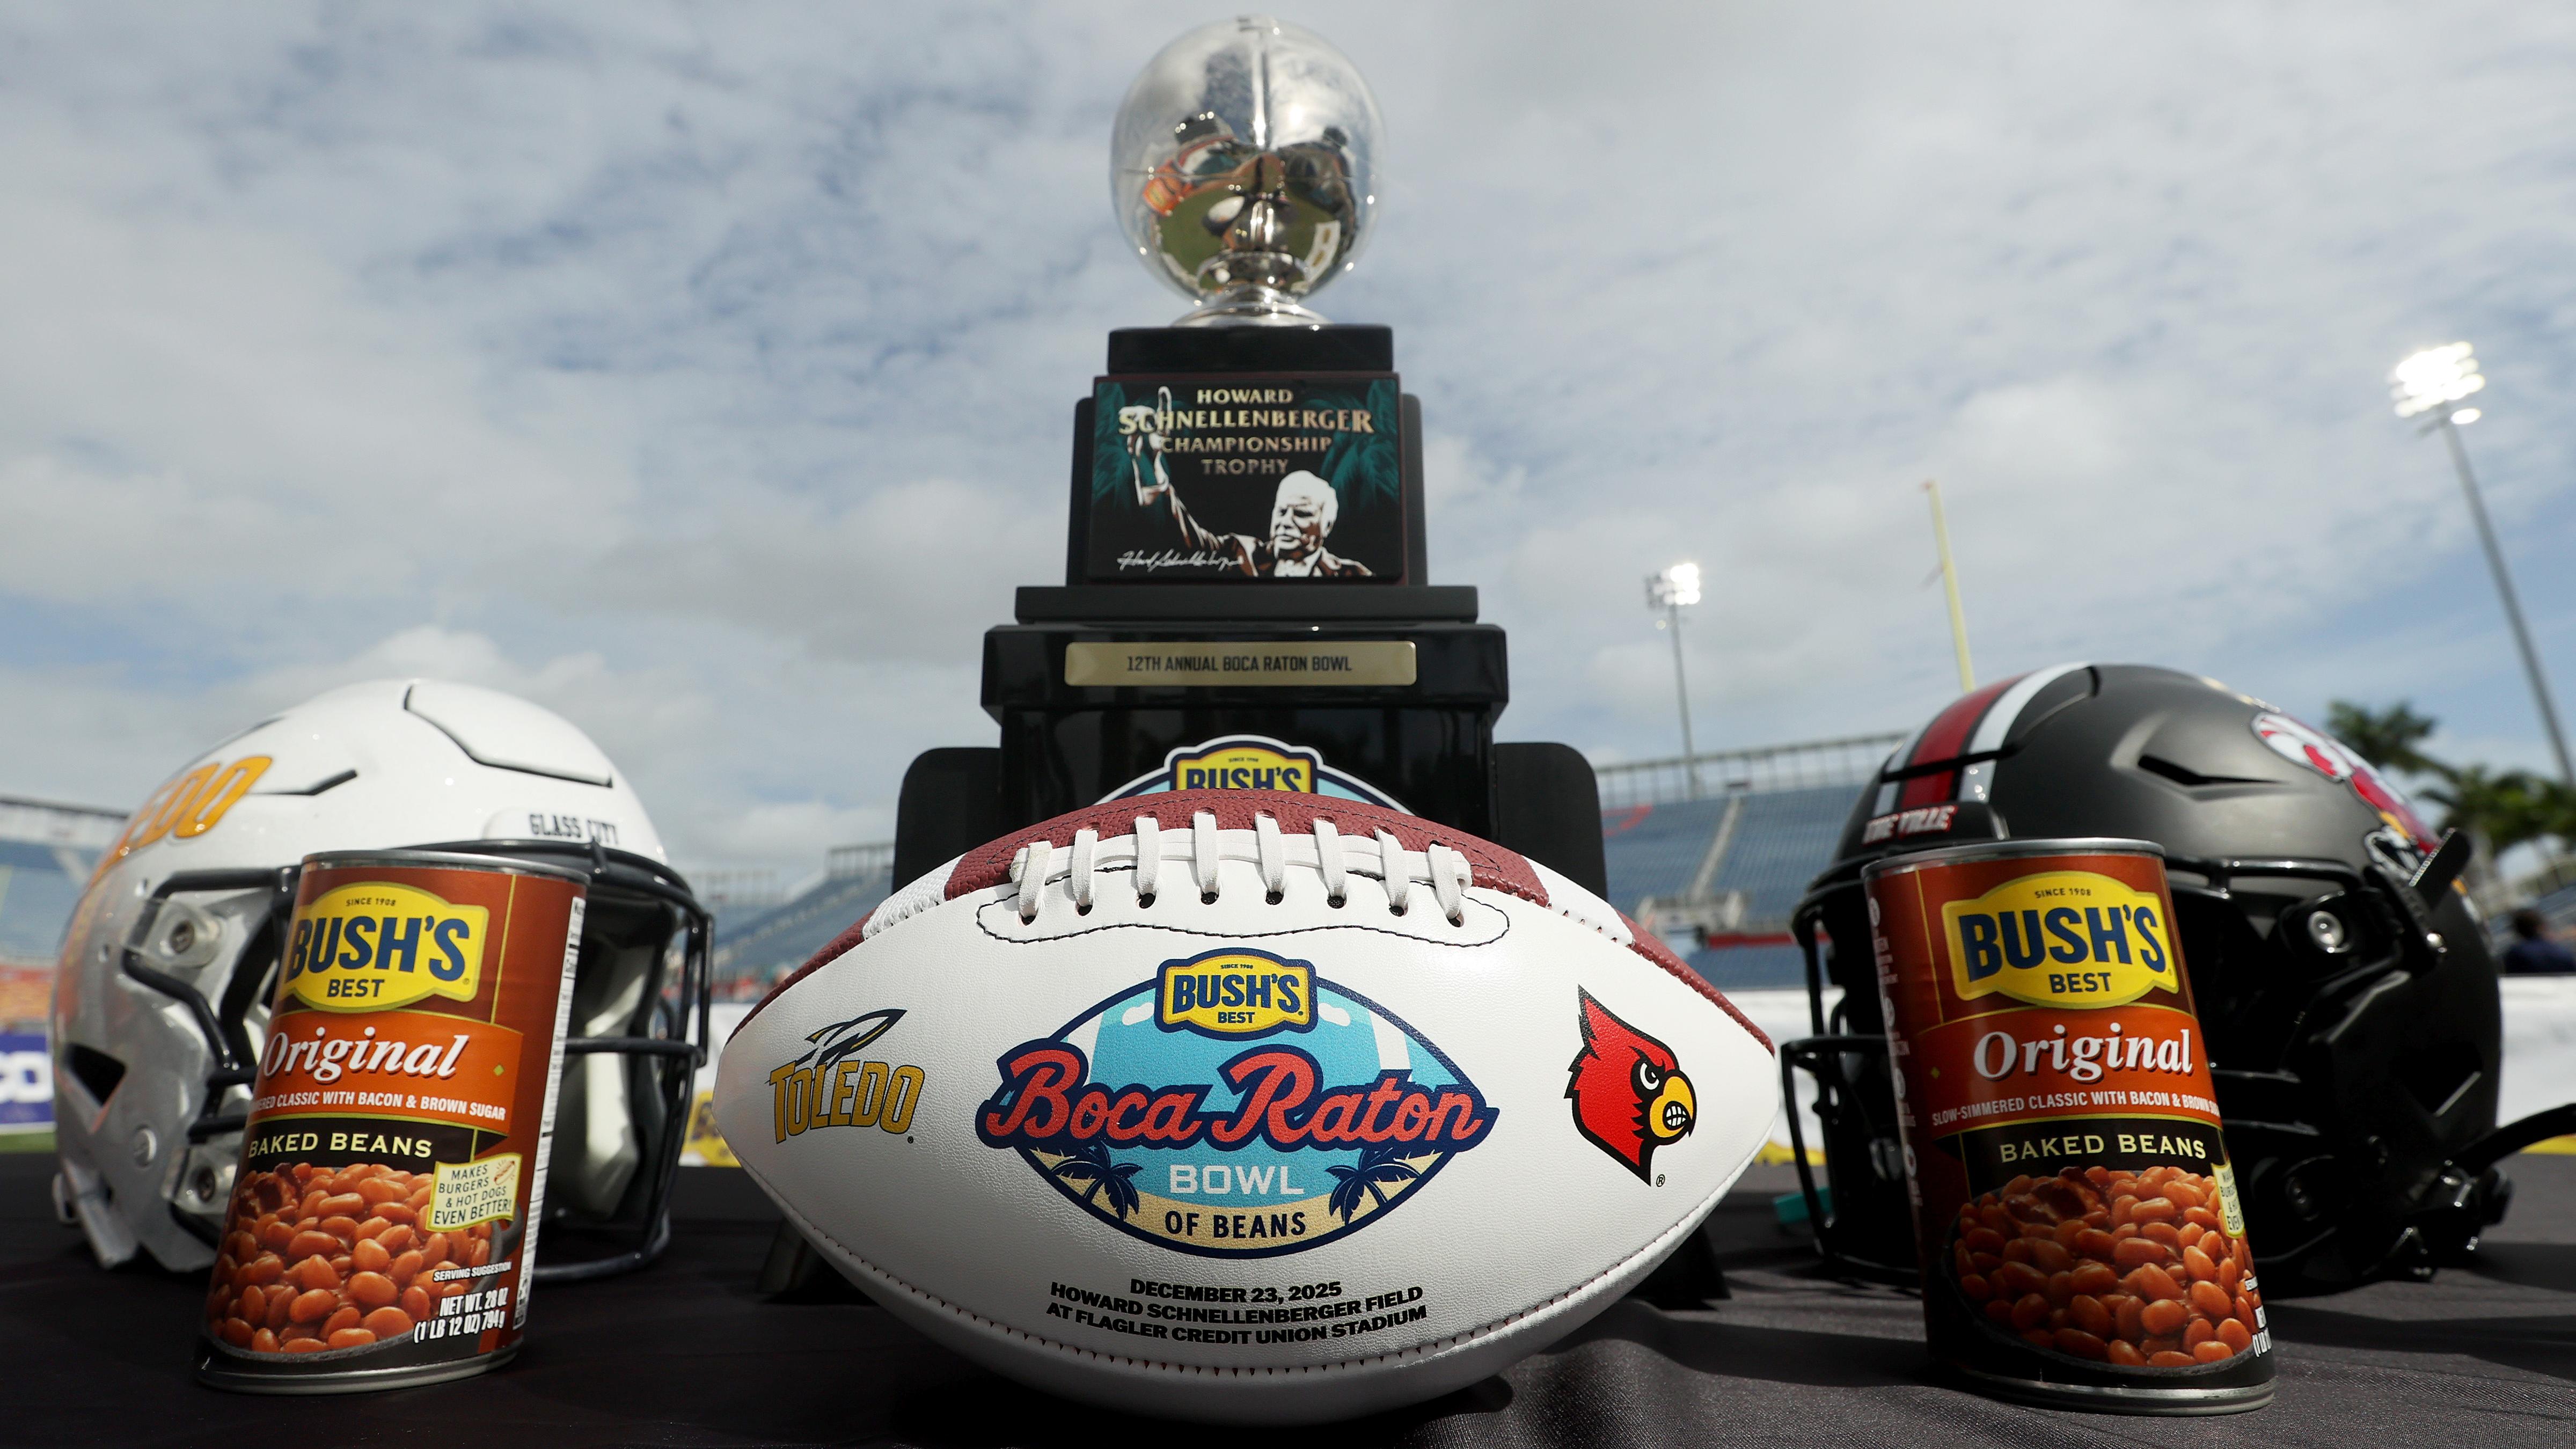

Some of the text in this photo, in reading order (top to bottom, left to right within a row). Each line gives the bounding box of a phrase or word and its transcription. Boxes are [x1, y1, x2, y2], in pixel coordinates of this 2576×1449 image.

[1197, 389, 1293, 405] HOWARD
[1118, 409, 1374, 435] SCHNELLENBERGER
[1160, 436, 1333, 453] CHAMPIONSHIP
[1201, 458, 1289, 475] TROPHY
[1128, 656, 1352, 671] 12TH ANNUAL BOCA RATON BOWL
[346, 897, 396, 906] SINCE 1908
[2035, 887, 2091, 898] SINCE 1908
[284, 916, 470, 984] BUSH'S
[1959, 904, 2166, 983] BUSH'S
[327, 979, 385, 997] BEST
[1172, 974, 1301, 1014] BUSH'S
[2048, 972, 2111, 993] BEST
[1218, 1012, 1255, 1023] BEST
[265, 1027, 470, 1084] Original
[1974, 1022, 2193, 1082] Original
[277, 1092, 319, 1107] CLASSIC
[323, 1091, 355, 1104] WITH
[358, 1092, 403, 1108] BACON
[406, 1095, 416, 1108] &
[421, 1097, 467, 1114] BROWN
[469, 1103, 506, 1121] SUGAR
[769, 1060, 925, 1144] TOLEDO
[986, 1050, 1483, 1143] Boca Raton
[1933, 1097, 2025, 1126] SLOW-SIMMERED
[2028, 1092, 2088, 1110] CLASSIC
[2091, 1091, 2127, 1106] WITH
[2130, 1091, 2170, 1107] BACON
[2172, 1093, 2181, 1107] &
[248, 1132, 433, 1159] BAKED BEANS
[2000, 1134, 2206, 1163] BAKED BEANS
[438, 1177, 489, 1194] BURGERS
[451, 1165, 488, 1181] MAKES
[1169, 1164, 1304, 1195] BOWL
[446, 1186, 506, 1208] & HOT DOGS
[434, 1199, 512, 1225] EVEN BETTER!
[1165, 1210, 1306, 1239] OF BEANS
[434, 1261, 512, 1282] SERVING SUGGESTION
[440, 1287, 509, 1316] NET WT. 28 OZ
[1051, 1282, 1423, 1324] HOWARD SCHNELLENBERGER FIELD
[1130, 1278, 1342, 1305] DECEMBER 23, 2025
[413, 1321, 427, 1343] (1
[429, 1319, 446, 1340] LB
[449, 1316, 463, 1336] 12
[463, 1313, 481, 1334] OZ)
[1046, 1302, 1427, 1344] AT FLAGLER CREDIT UNION STADIUM
